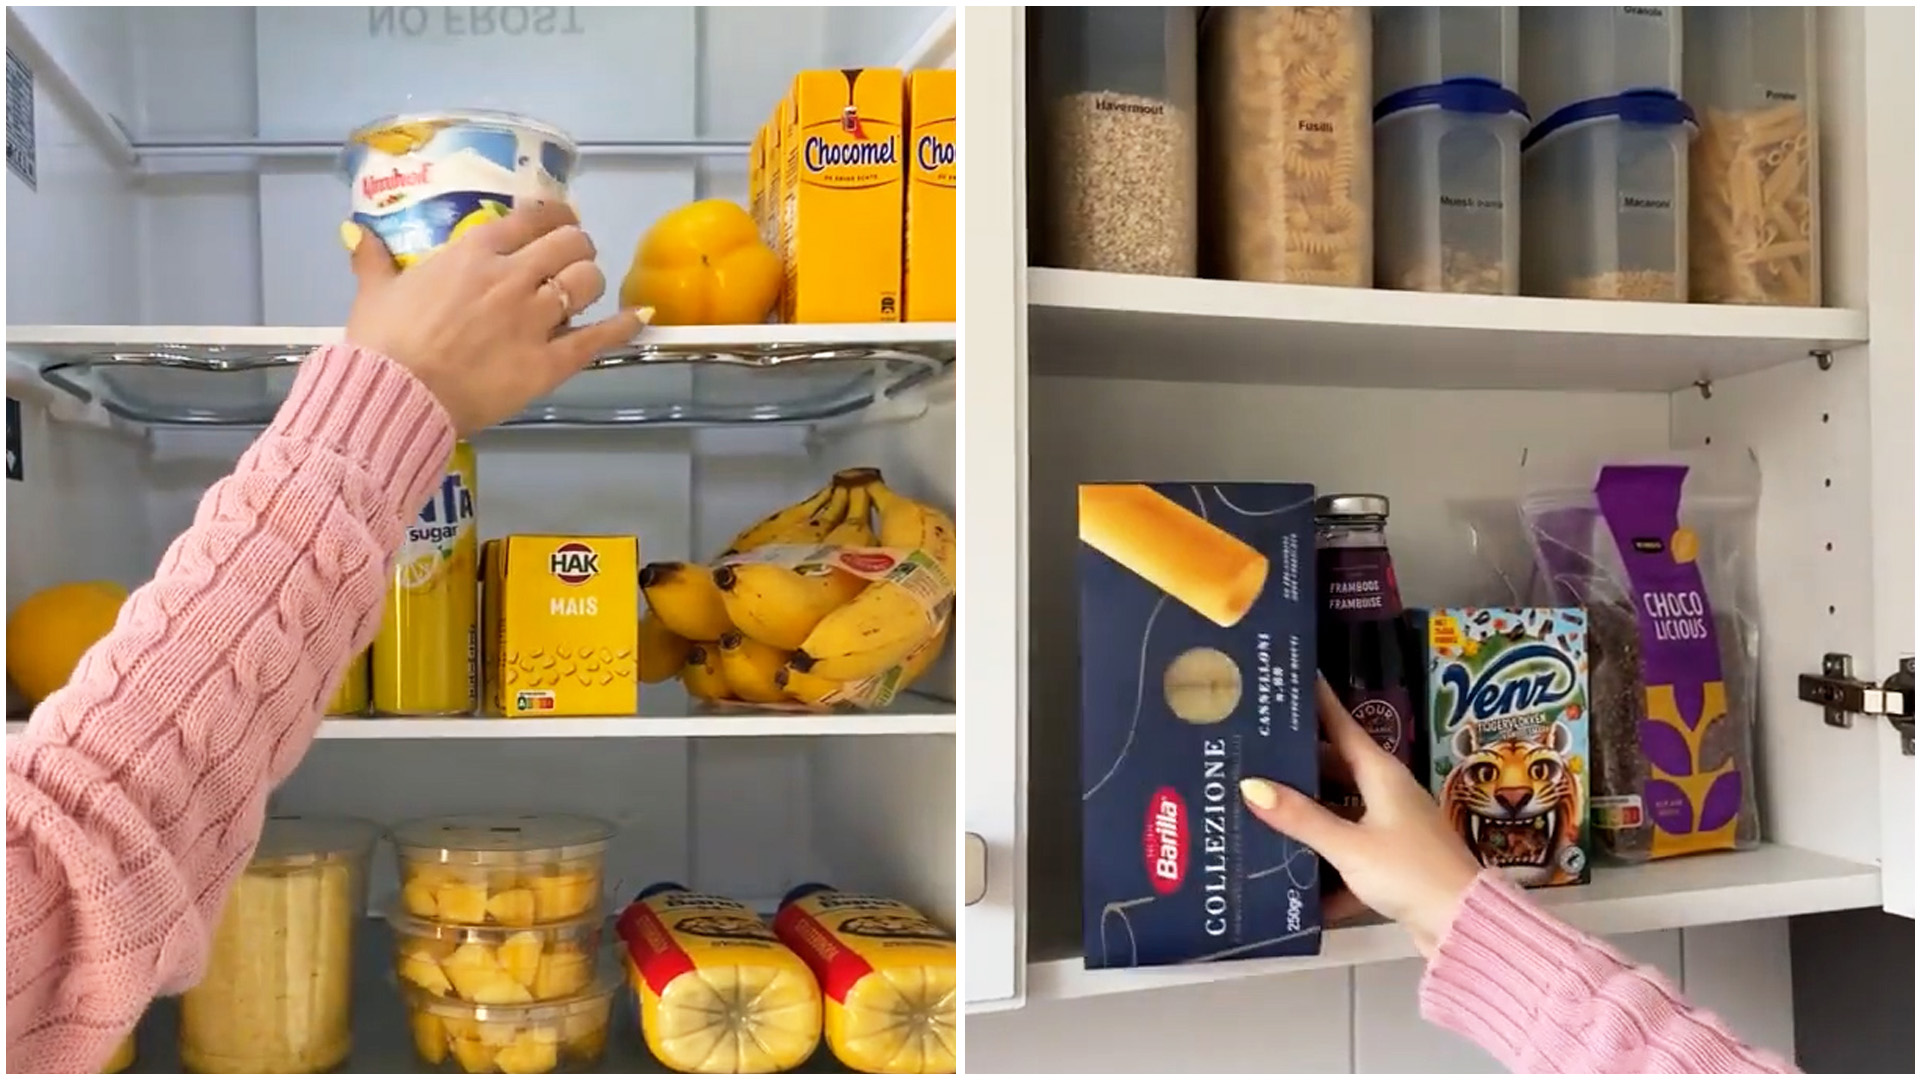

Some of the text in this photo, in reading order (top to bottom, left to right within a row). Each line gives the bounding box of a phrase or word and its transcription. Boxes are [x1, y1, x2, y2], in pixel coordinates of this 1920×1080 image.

[1096, 99, 1164, 115] Havermout
[1298, 120, 1334, 134] Fusilli
[805, 135, 897, 172] Chocomel
[918, 135, 956, 171] Cho
[408, 525, 458, 543] sugar
[551, 554, 599, 573] HAK
[550, 597, 599, 617] MAIS
[1643, 591, 1704, 618] CHOCO
[1653, 618, 1708, 641] LICIOUS
[1441, 644, 1577, 728] Venz
[1155, 797, 1179, 881] Barilla
[1204, 737, 1227, 937] COLLEZIONE
